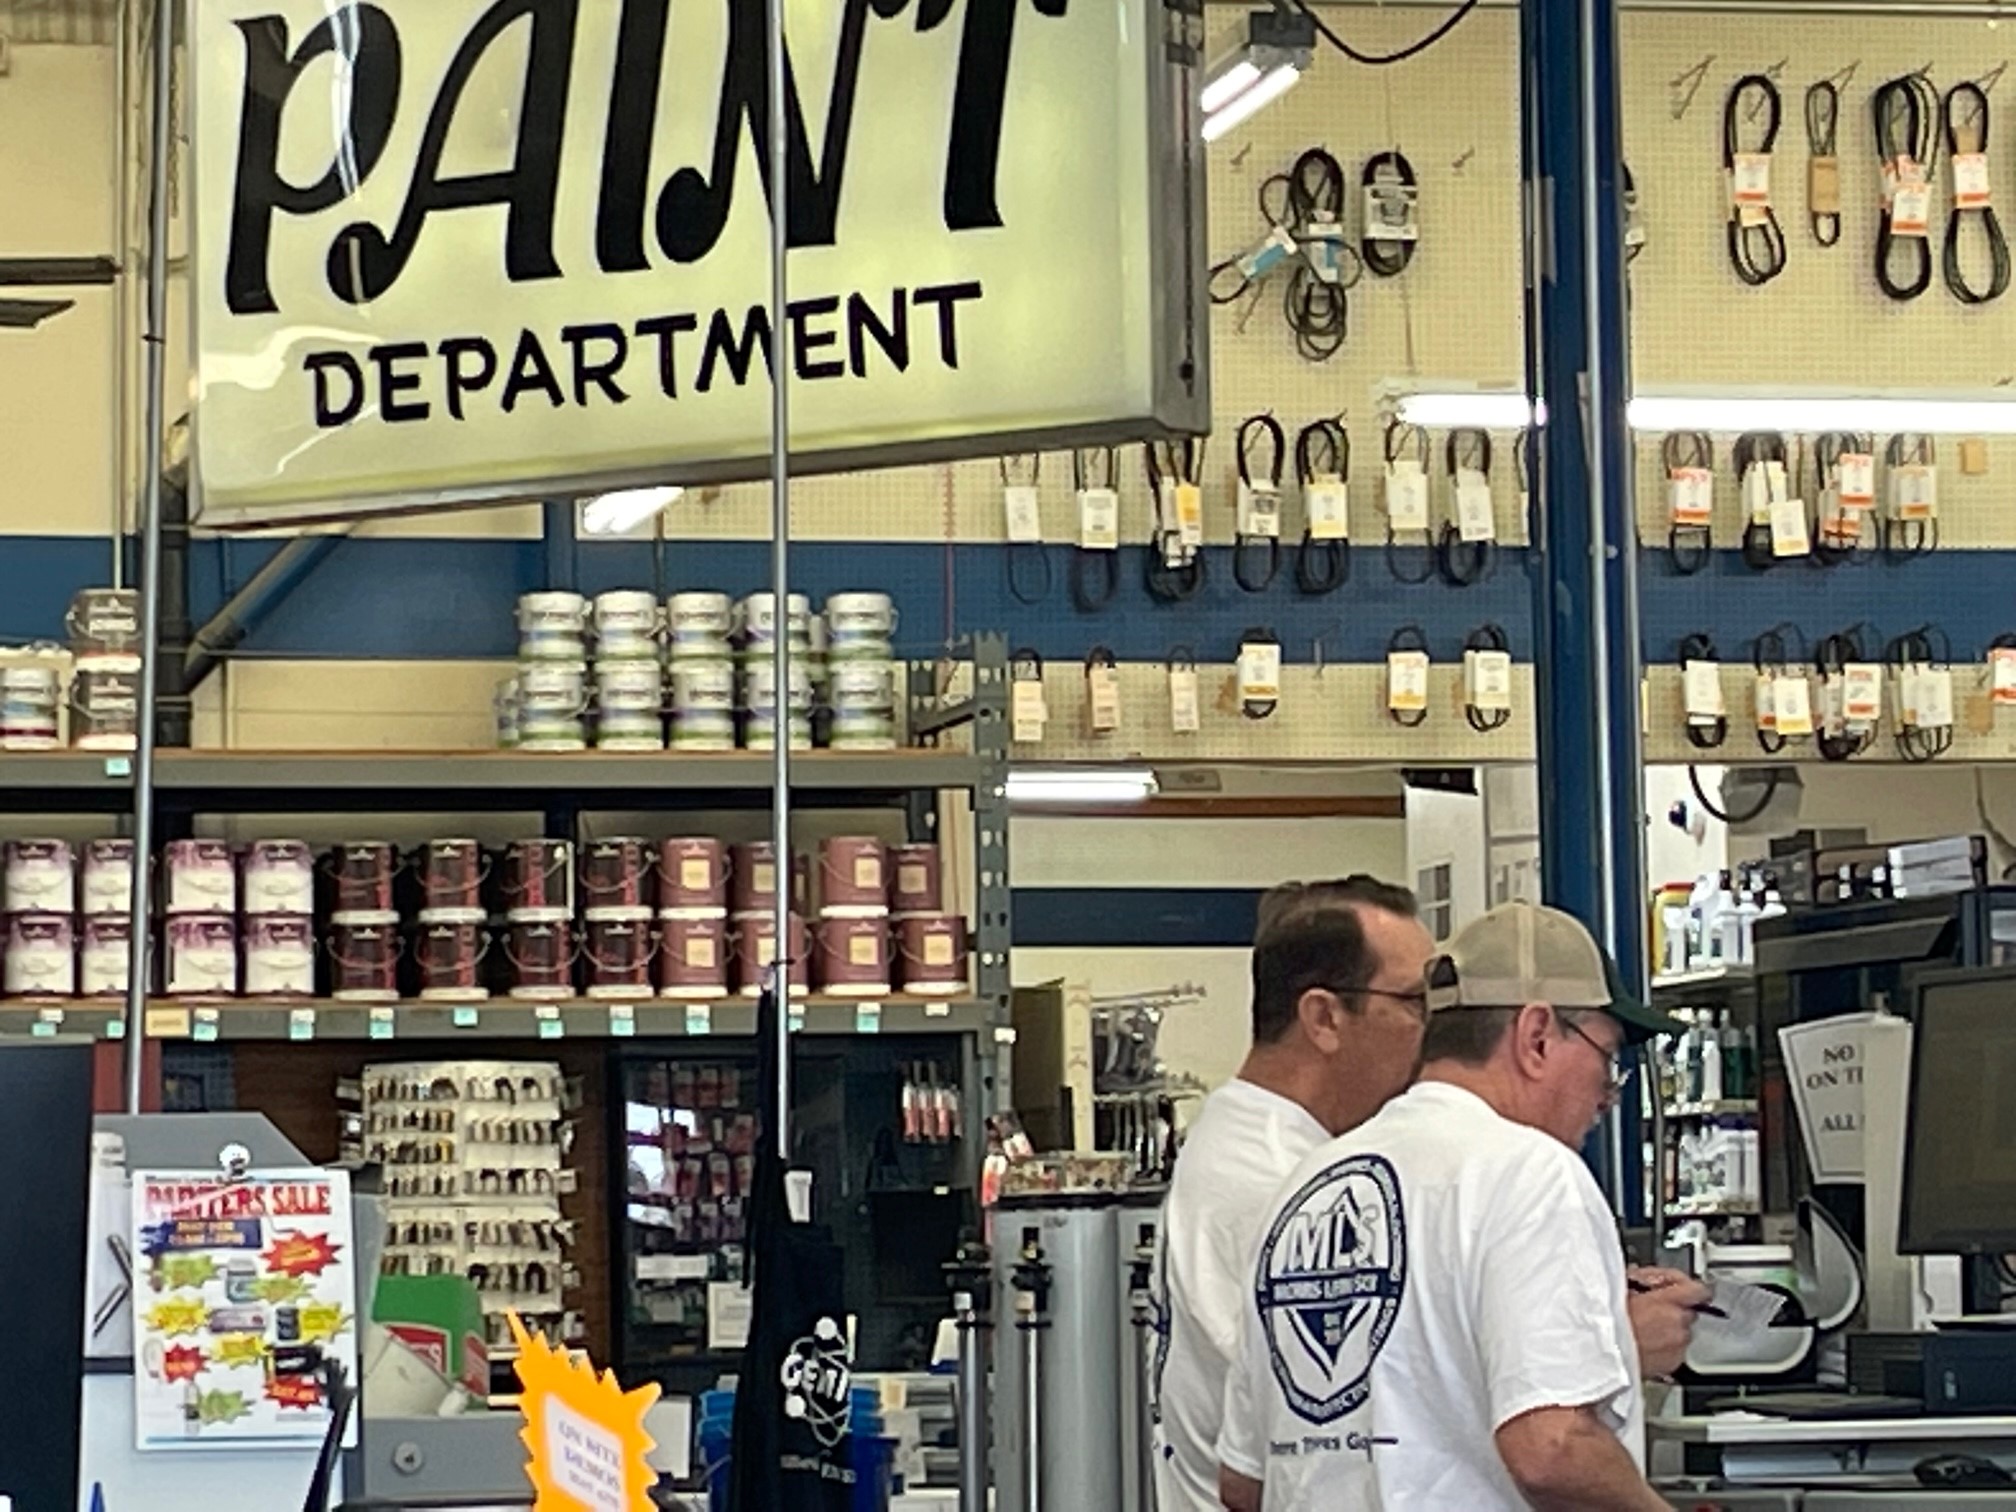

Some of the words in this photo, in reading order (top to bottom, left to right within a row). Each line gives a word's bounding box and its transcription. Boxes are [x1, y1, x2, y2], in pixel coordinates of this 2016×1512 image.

[225, 0, 1068, 314] PAINT
[304, 282, 982, 428] DEPARTMENT
[1822, 1044, 1855, 1064] NO
[1806, 1070, 1838, 1090] ON
[1820, 1113, 1856, 1131] ALL
[272, 1184, 331, 1215] SALE
